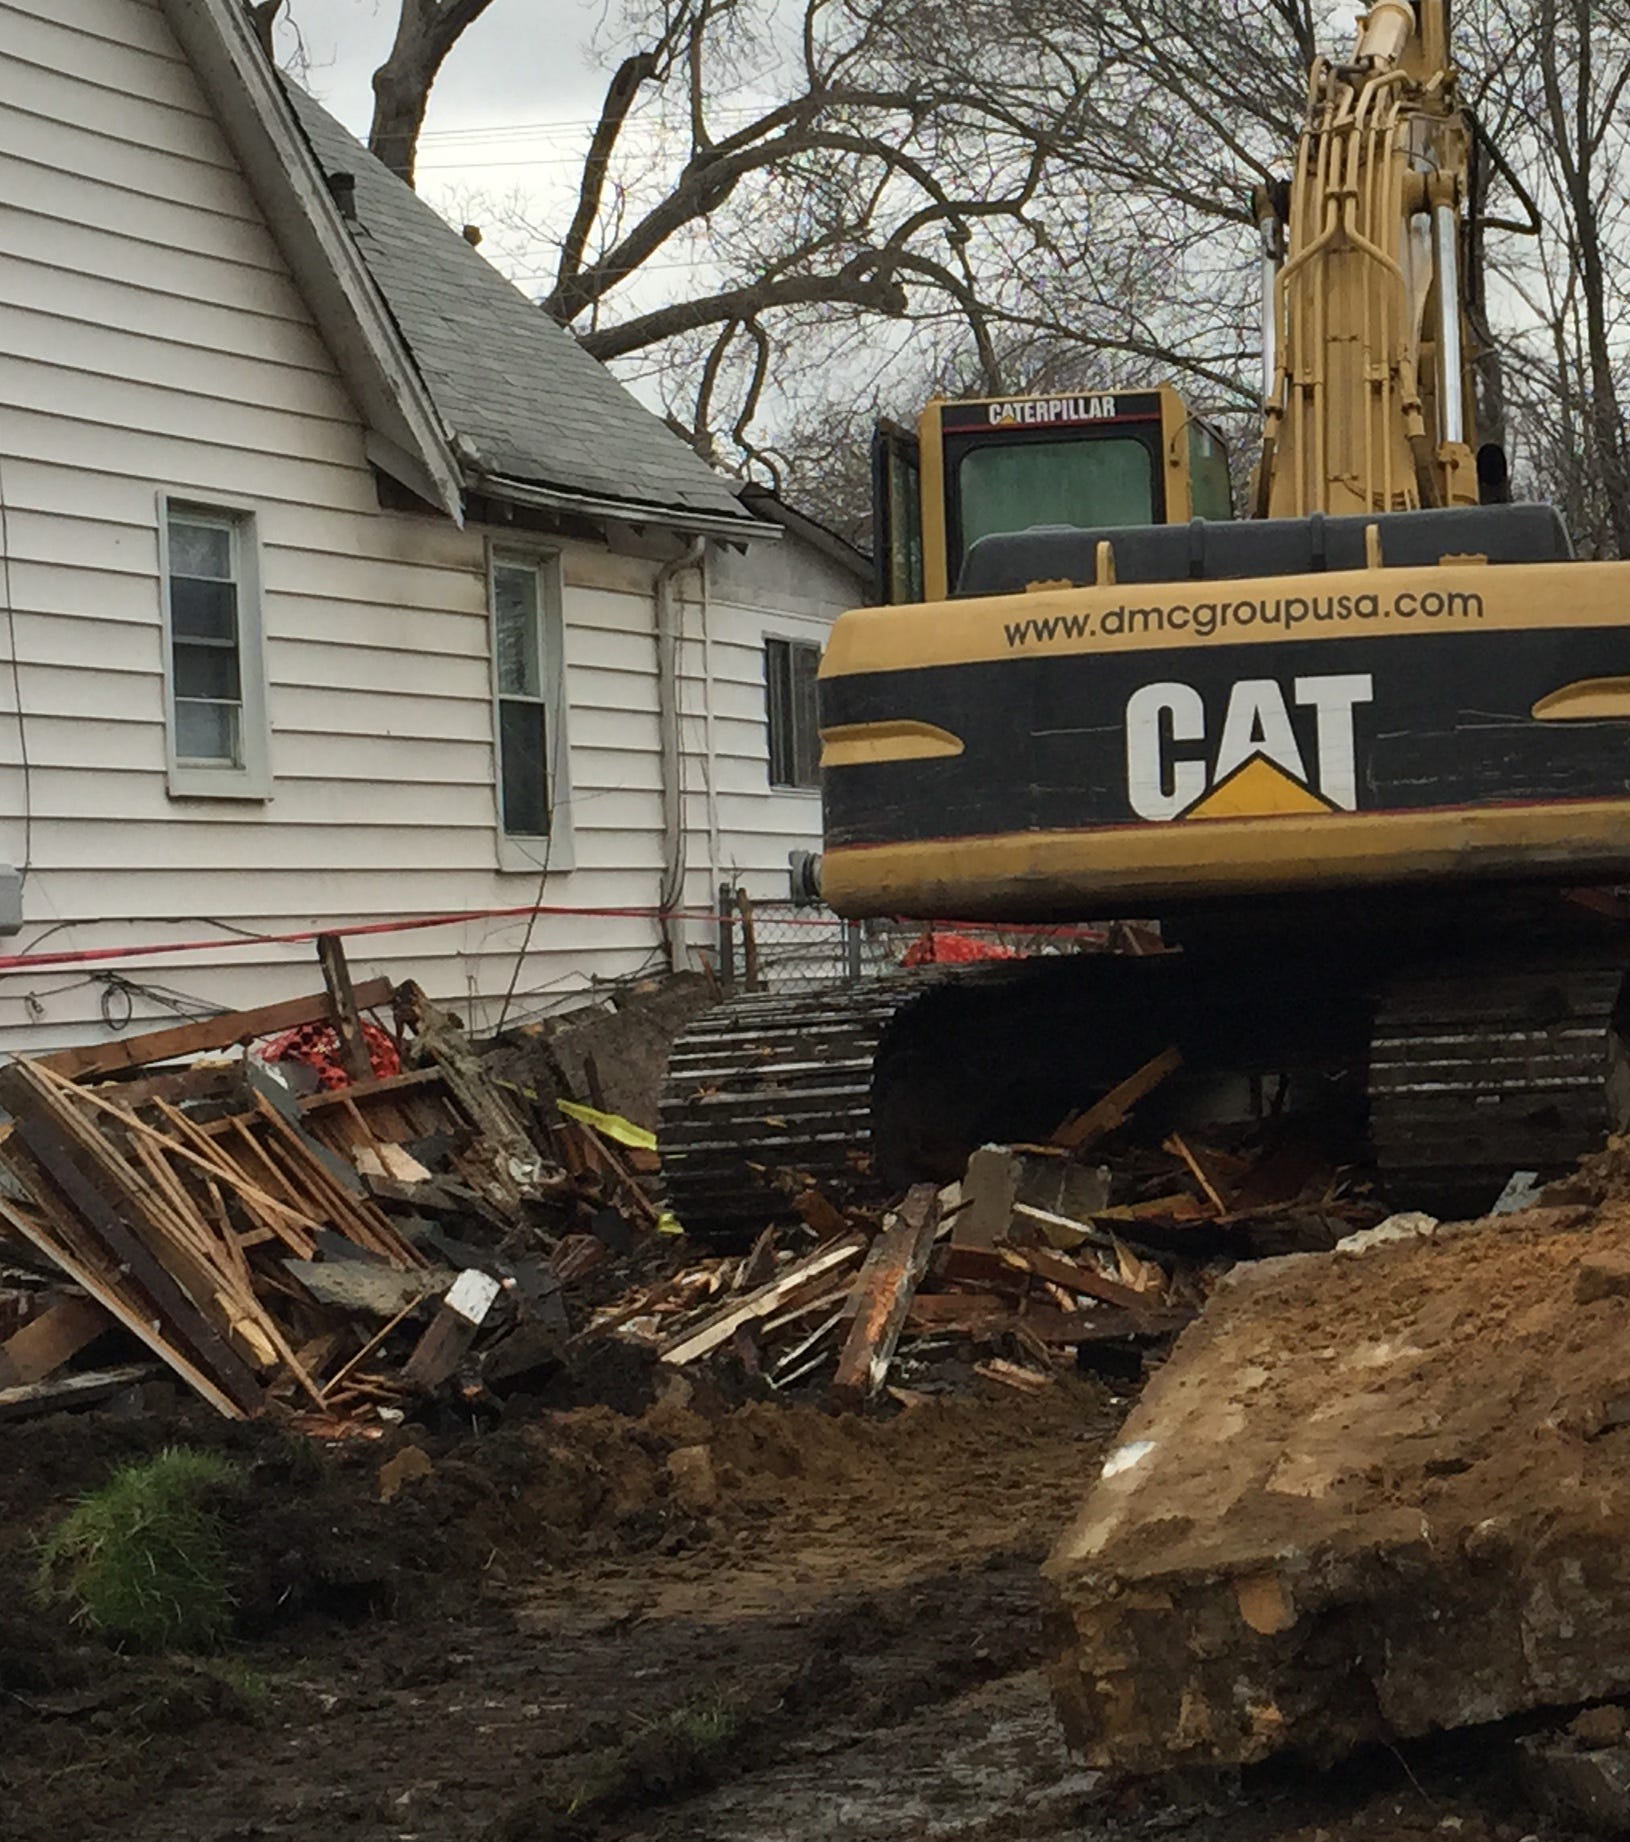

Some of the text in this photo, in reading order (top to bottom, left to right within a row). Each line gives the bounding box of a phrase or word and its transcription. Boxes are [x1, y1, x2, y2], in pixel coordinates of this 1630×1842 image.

[988, 396, 1116, 425] CATERPILLAR
[1004, 590, 1484, 647] www.dmcgroupusa.com
[1126, 673, 1374, 821] CAT
